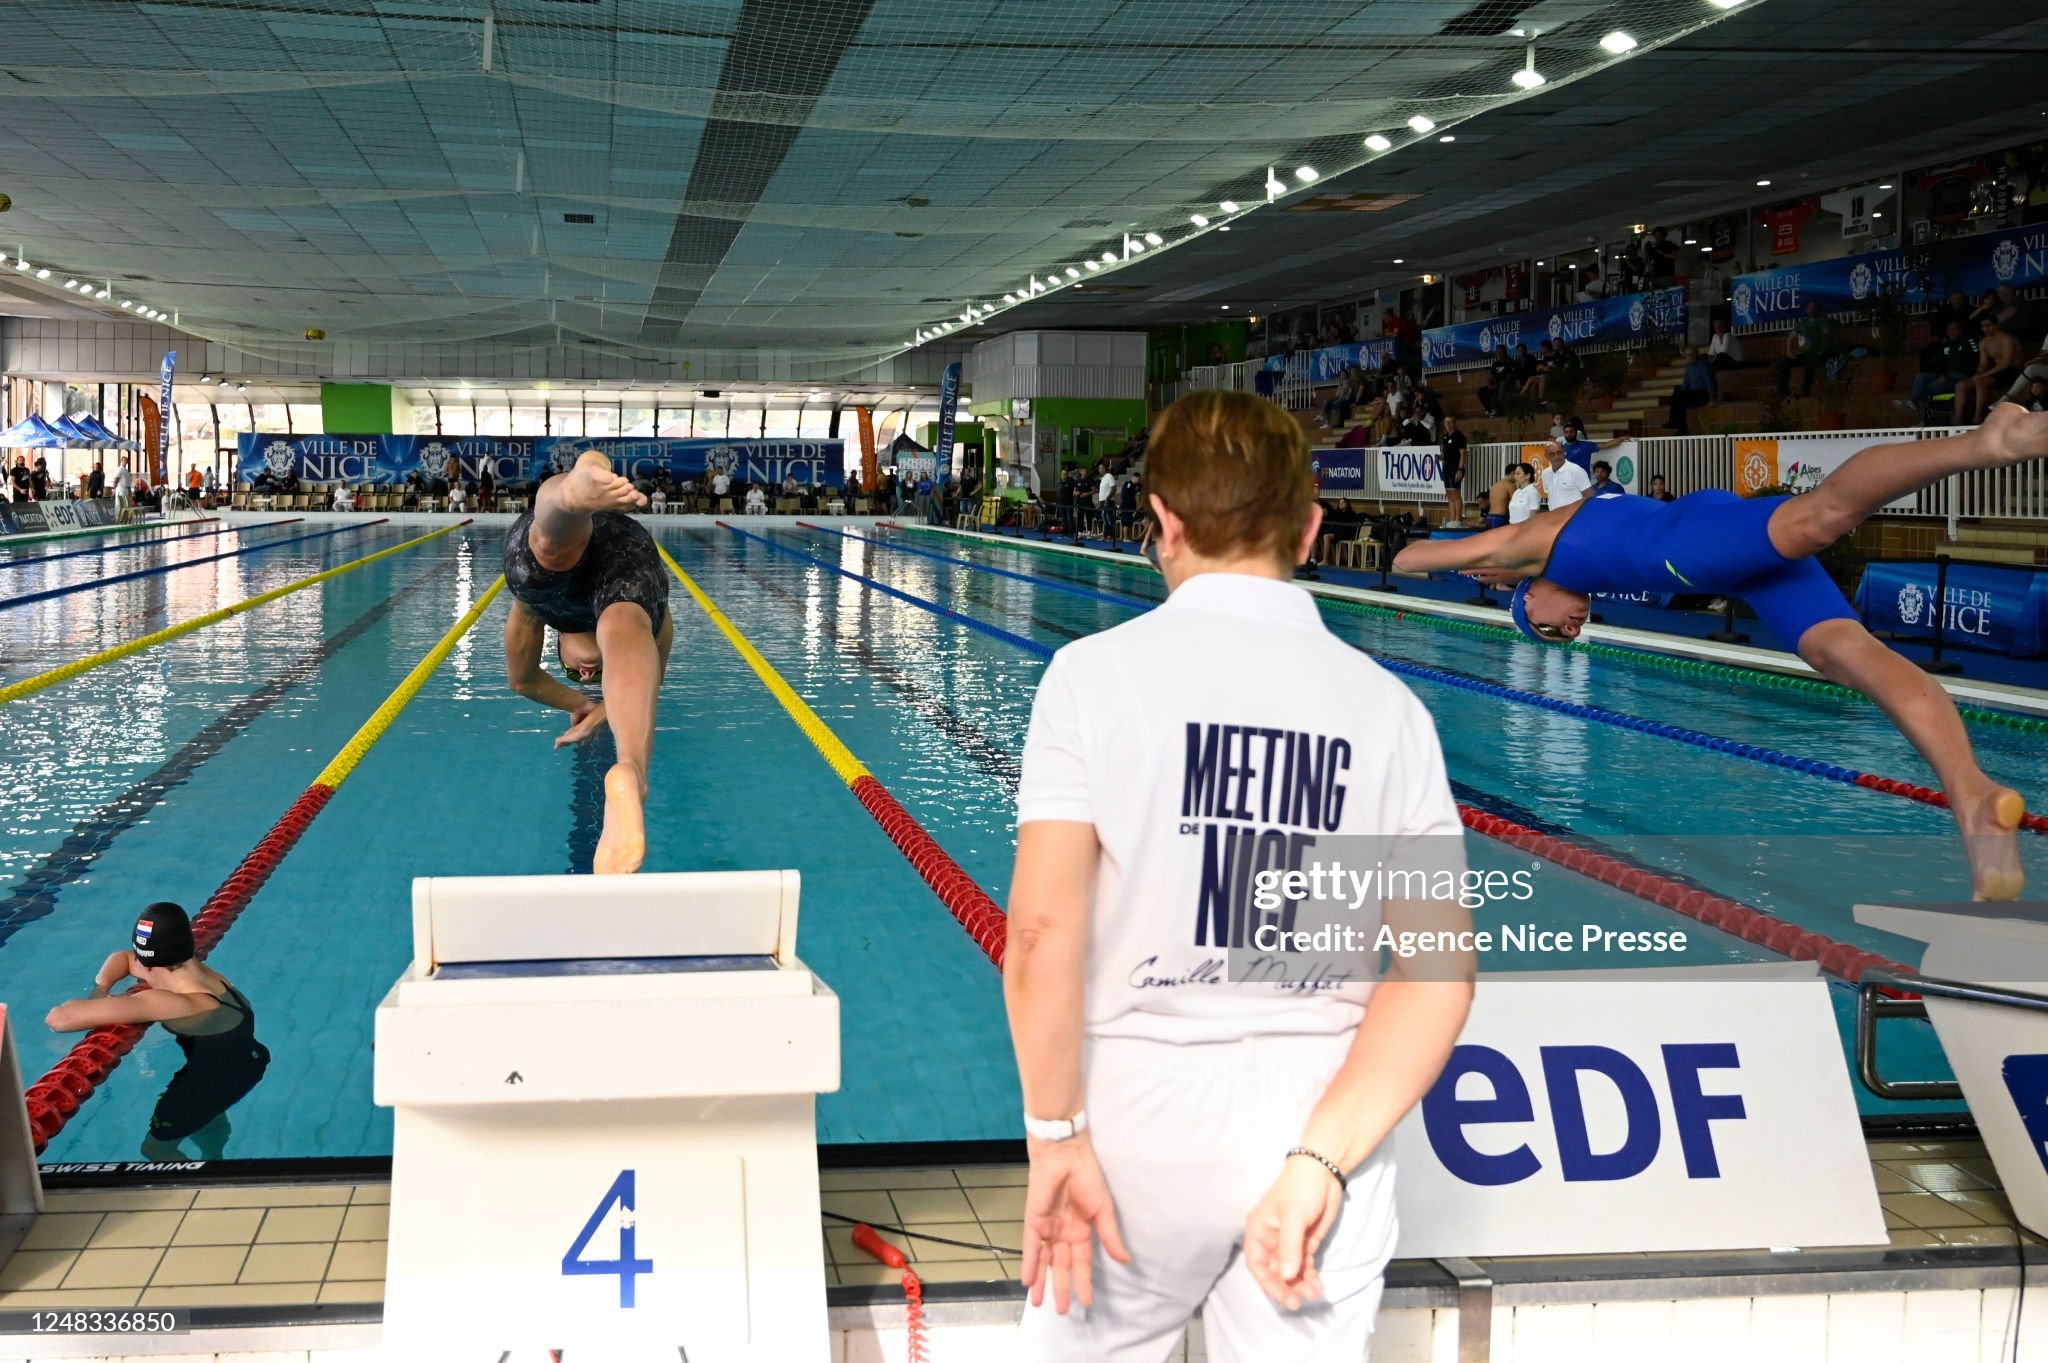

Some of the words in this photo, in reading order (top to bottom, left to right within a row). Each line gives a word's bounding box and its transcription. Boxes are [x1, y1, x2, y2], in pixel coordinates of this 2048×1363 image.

[1755, 277, 1783, 292] VILLE
[1786, 274, 1800, 288] DE
[1755, 288, 1800, 314] NICE
[1563, 310, 1583, 322] VILLE
[1585, 307, 1596, 318] DE
[1563, 320, 1596, 340] NICE
[1431, 342, 1456, 360] NICE
[945, 374, 957, 407] NICE
[300, 440, 348, 455] VILLE
[353, 441, 377, 455] DE
[456, 442, 502, 456] VILLE
[508, 442, 531, 456] DE
[647, 442, 673, 457] DE
[746, 443, 795, 458] VILLE
[801, 443, 826, 459] DE
[303, 456, 377, 480] NICE
[458, 457, 531, 480] NCE
[746, 459, 826, 484] NICE
[1927, 585, 1966, 604] VLLE
[1971, 590, 1991, 608] DE
[1926, 602, 1991, 635] NICE
[1182, 722, 1352, 832] MEETING
[1179, 823, 1199, 835] DE
[1195, 824, 1316, 954] NICE
[1128, 955, 1225, 989] Camille
[1421, 1042, 1747, 1187] eDF
[40, 1163, 120, 1174] SWISS
[124, 1161, 206, 1171] TIMING
[561, 1169, 653, 1308] 4
